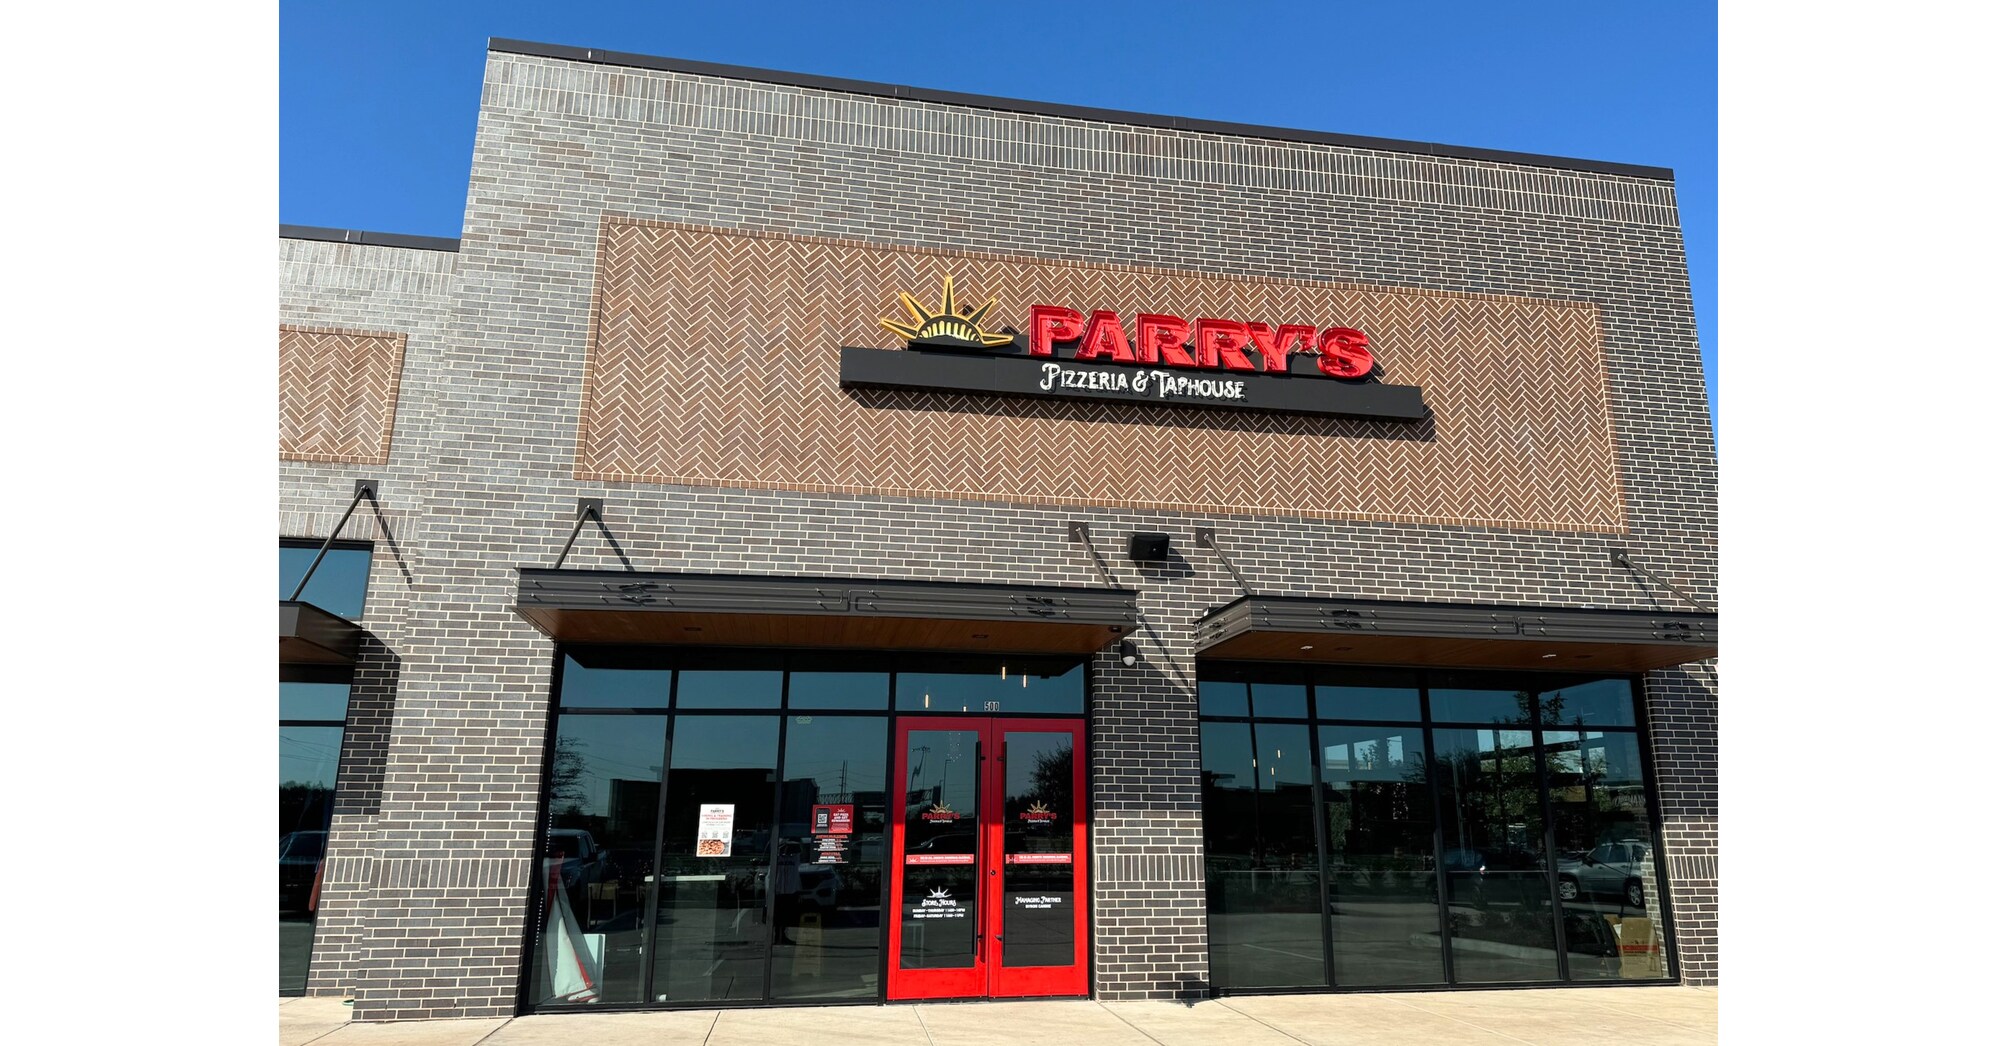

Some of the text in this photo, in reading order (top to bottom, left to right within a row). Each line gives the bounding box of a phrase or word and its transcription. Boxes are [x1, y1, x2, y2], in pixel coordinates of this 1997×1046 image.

[1029, 304, 1374, 378] PARRY'S
[1040, 363, 1245, 398] PIZZERIA & TAPHOUSE
[984, 702, 999, 711] 500
[922, 812, 960, 820] PARRY'S
